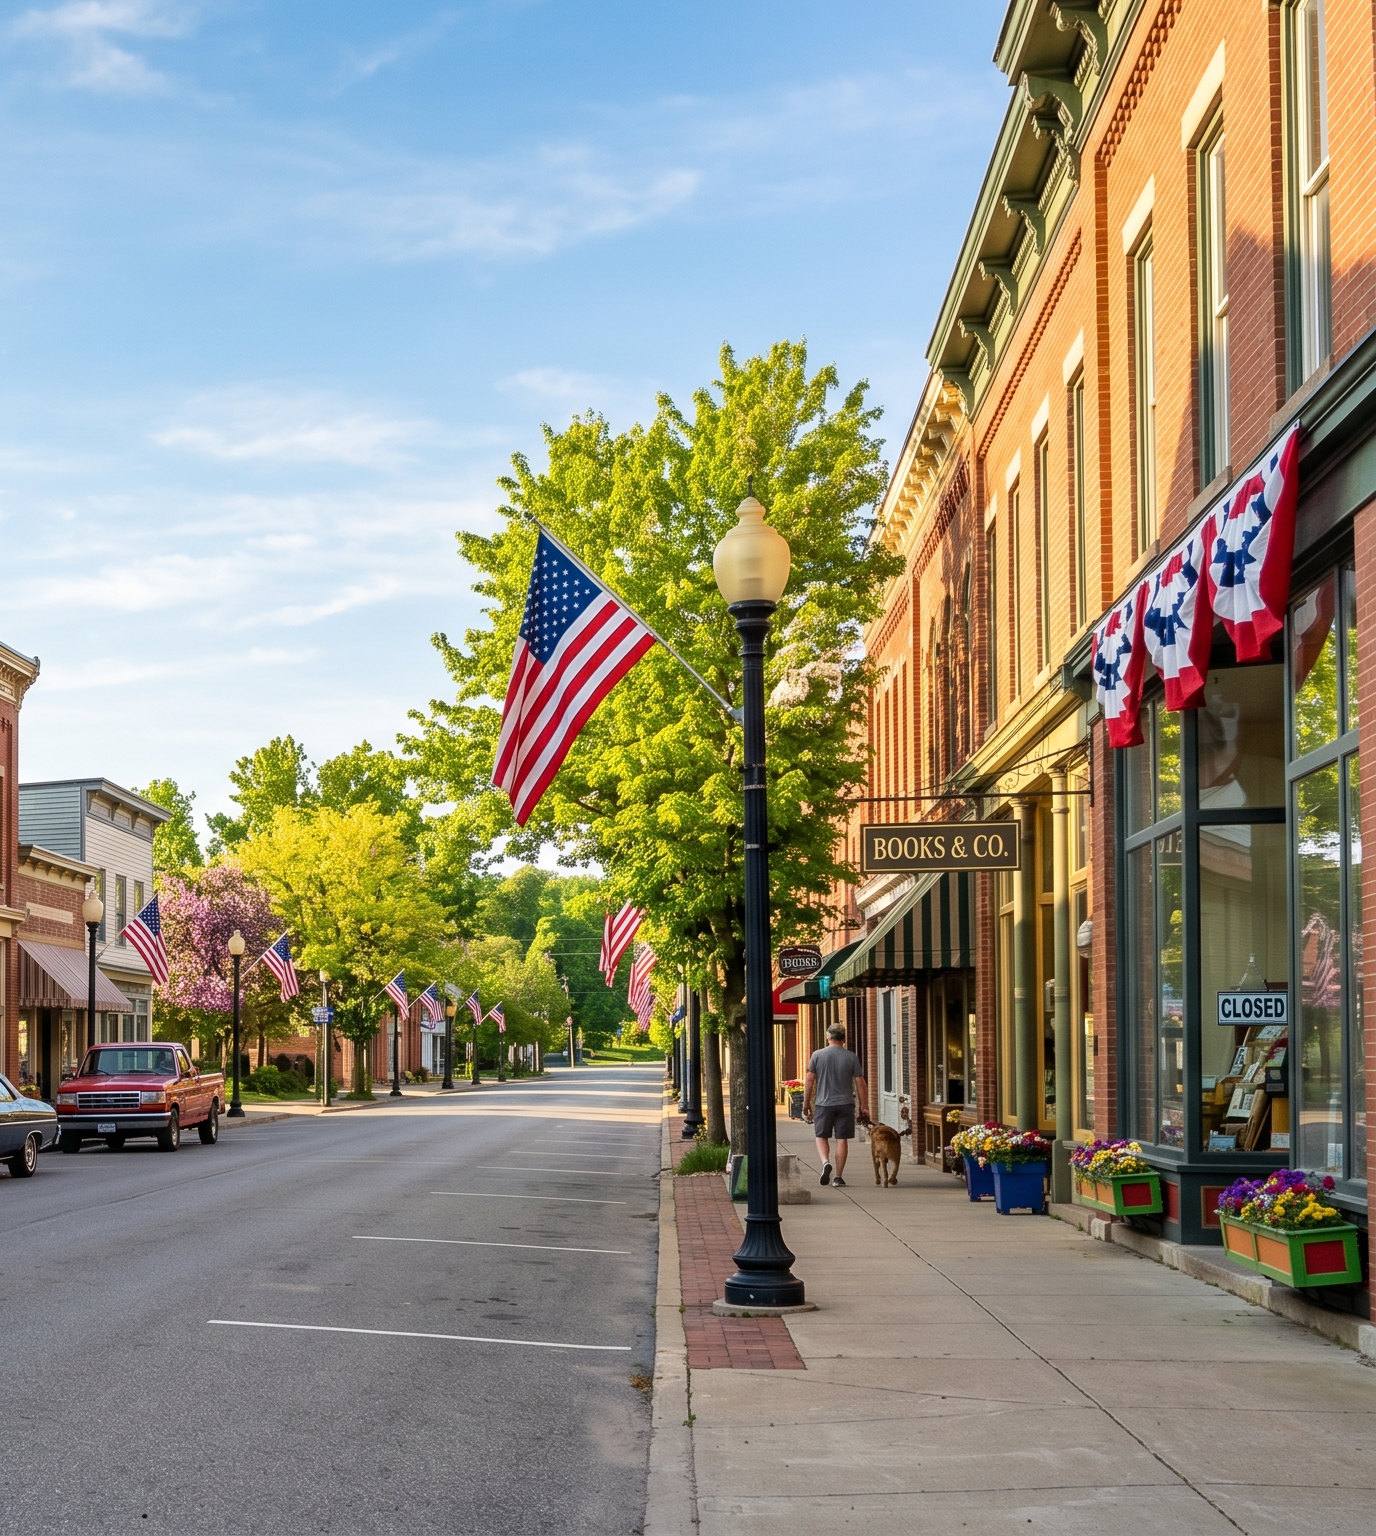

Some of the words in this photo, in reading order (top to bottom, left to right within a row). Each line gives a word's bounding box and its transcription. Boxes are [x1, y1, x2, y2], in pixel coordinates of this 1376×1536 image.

[873, 835, 946, 860] BOOKS
[951, 835, 968, 858] &
[973, 834, 1009, 858] CO.
[1221, 997, 1285, 1019] CLOSED
